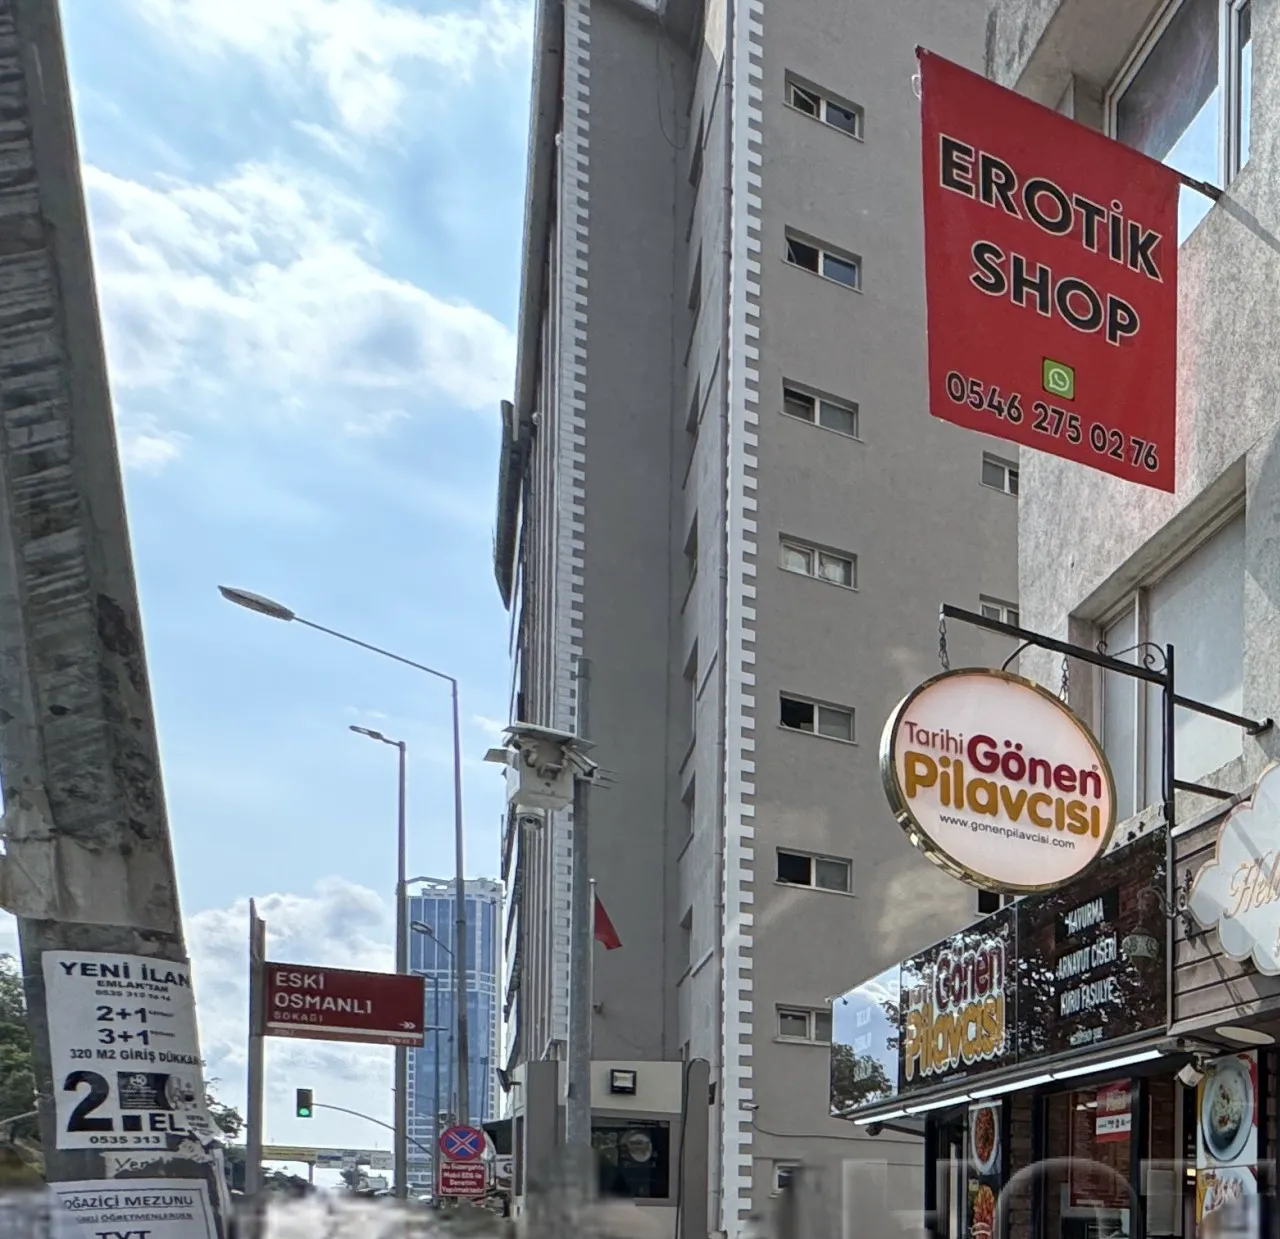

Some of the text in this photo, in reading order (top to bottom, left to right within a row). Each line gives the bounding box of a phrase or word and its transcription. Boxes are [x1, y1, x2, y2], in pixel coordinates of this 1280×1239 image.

[939, 132, 1163, 284] EROTİK
[970, 240, 1139, 346] SHOP
[946, 370, 1160, 472] 0546 275 02 76
[905, 721, 1102, 799] Tarihi Gönen
[904, 751, 1100, 838] Pilavcısı
[60, 962, 191, 988] YENİ İLAN
[275, 971, 325, 990] ESKİ
[275, 992, 372, 1014] OSMANLI
[97, 1006, 147, 1023] 2+1
[98, 1028, 150, 1045] 3+1
[70, 1048, 92, 1060] 320
[96, 1050, 116, 1060] M2
[119, 1048, 156, 1063] GİRİŞ
[90, 1135, 160, 1144] 0535 313
[64, 1195, 193, 1209] OĞAZİÇİ MEZUNU
